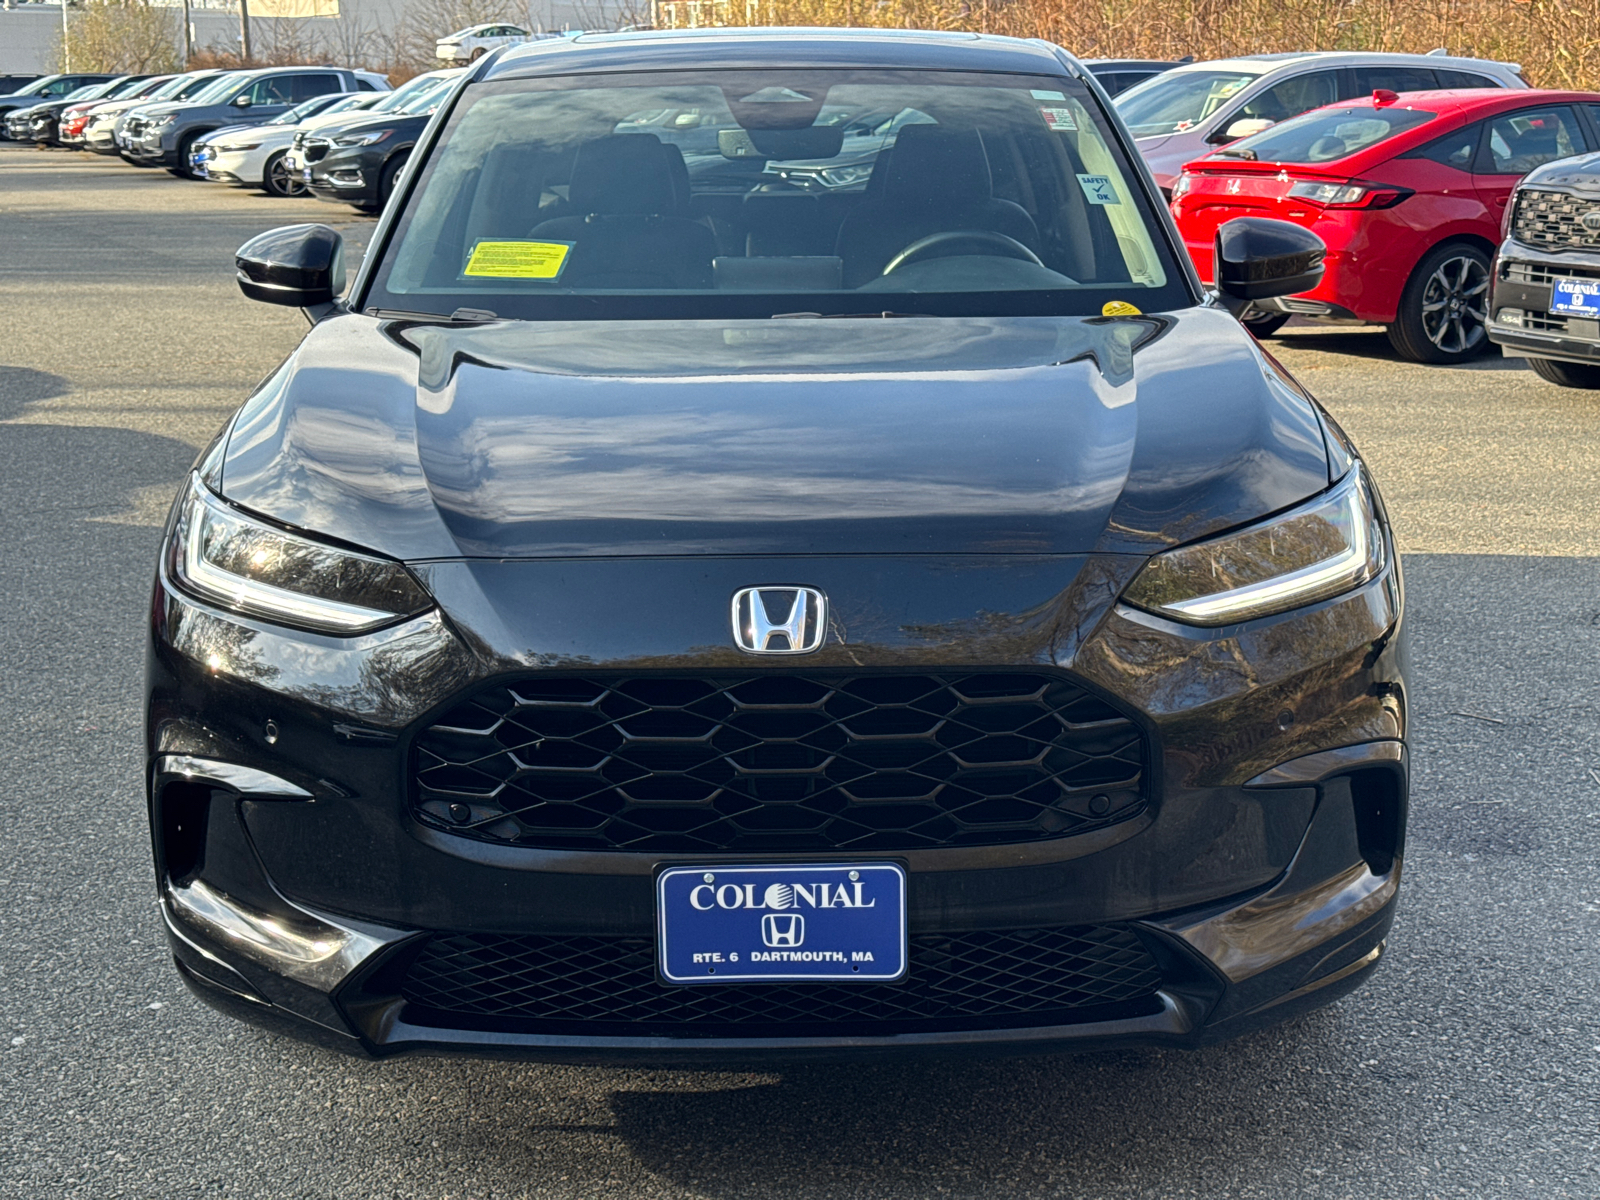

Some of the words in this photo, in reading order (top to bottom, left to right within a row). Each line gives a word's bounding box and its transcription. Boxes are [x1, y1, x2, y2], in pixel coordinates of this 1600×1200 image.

[690, 882, 876, 910] COLONIAL
[693, 952, 726, 963] RTE.
[729, 952, 739, 962] 6
[751, 951, 848, 963] DARTMOUTH,
[852, 951, 874, 962] MA
